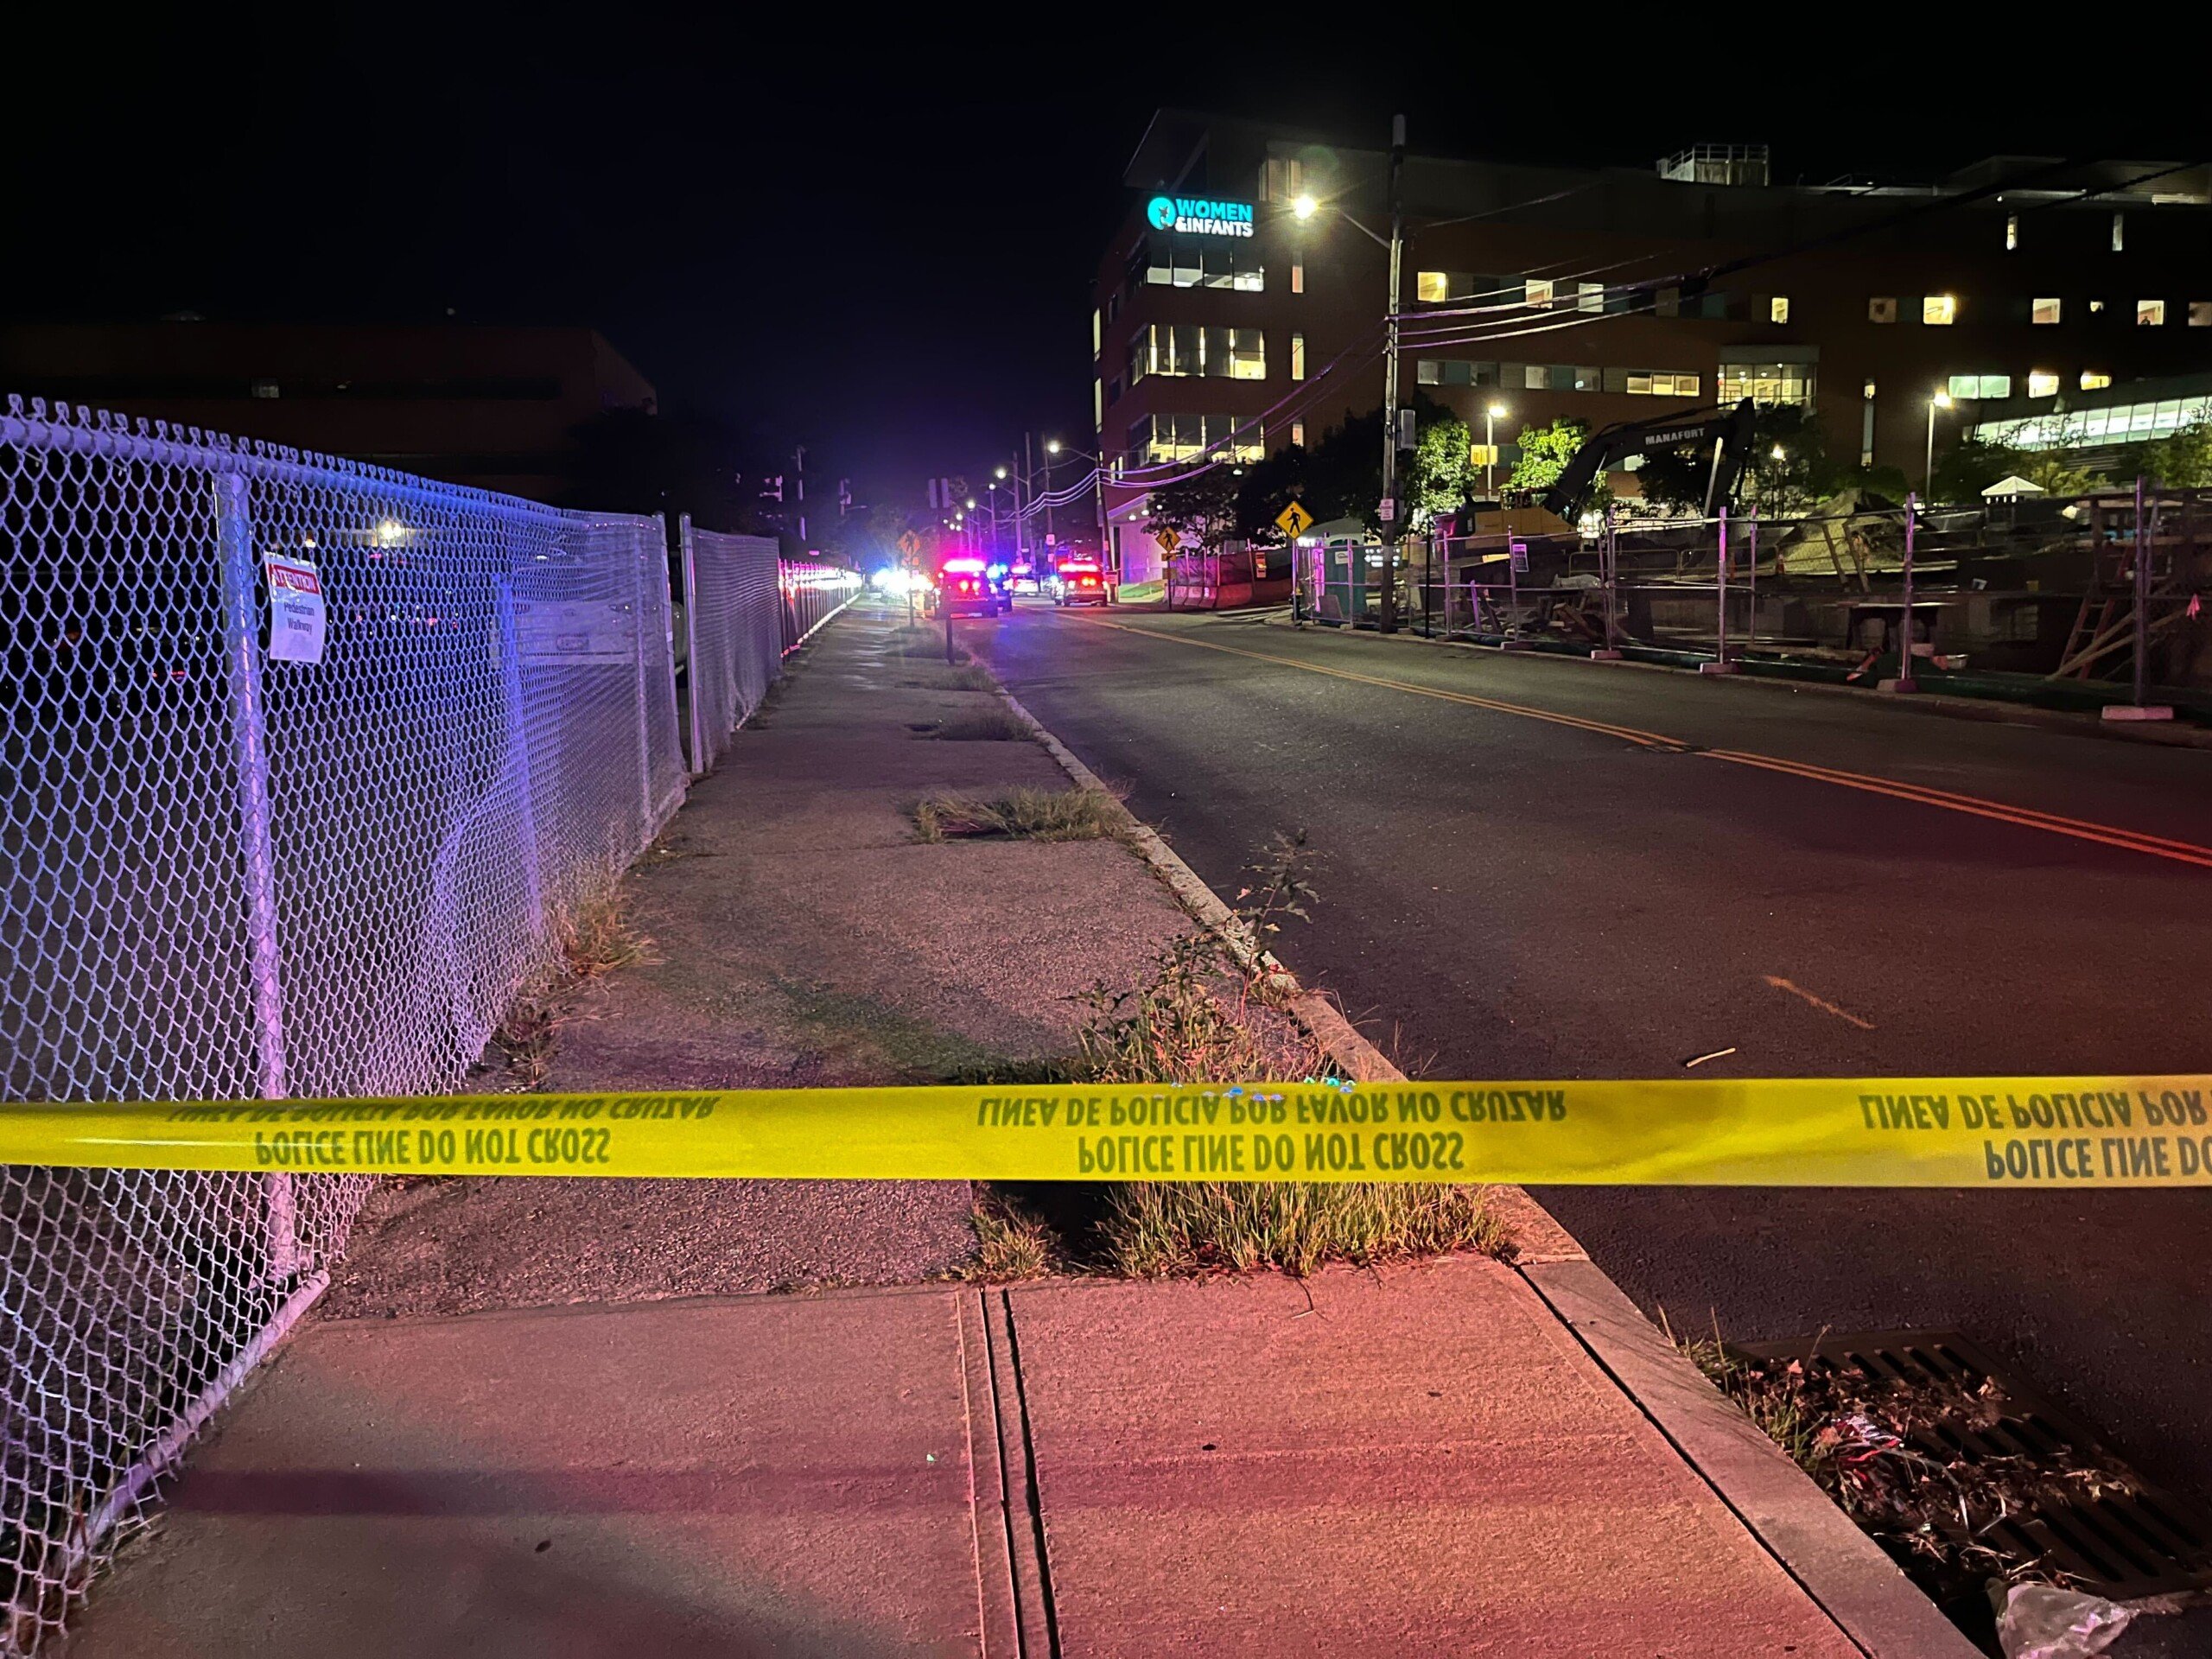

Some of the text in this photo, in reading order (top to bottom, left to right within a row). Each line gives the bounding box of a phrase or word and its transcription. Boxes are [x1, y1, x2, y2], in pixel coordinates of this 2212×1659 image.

[1175, 199, 1253, 222] WOMEN
[1645, 428, 1705, 445] MANAFORT
[271, 569, 317, 592] ATTENTION
[287, 617, 313, 635] Walkway
